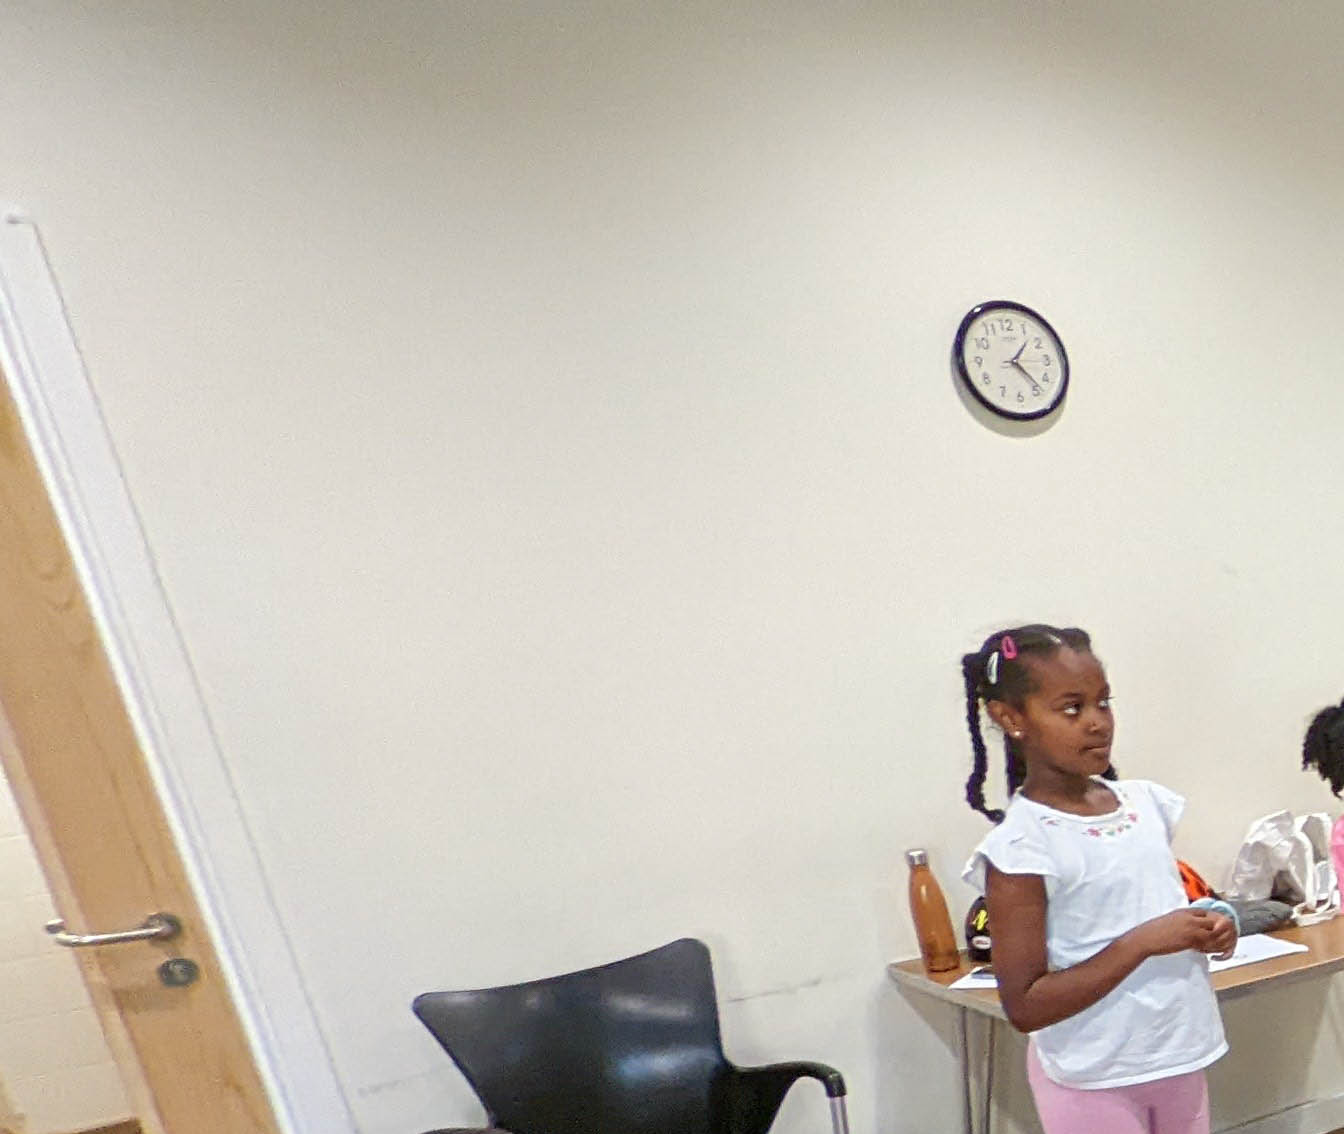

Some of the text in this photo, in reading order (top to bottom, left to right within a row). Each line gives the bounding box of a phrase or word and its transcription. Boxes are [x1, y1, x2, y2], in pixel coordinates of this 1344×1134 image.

[983, 322, 996, 336] 11
[998, 319, 1014, 331] 12
[975, 338, 989, 350] 10
[1034, 338, 1042, 349] 2
[974, 356, 982, 367] 9
[1042, 355, 1050, 366] 3
[983, 373, 991, 384] 8
[1042, 373, 1049, 383] 4
[1000, 386, 1006, 397] 7
[1032, 386, 1040, 396] 5
[1017, 392, 1024, 402] 6
